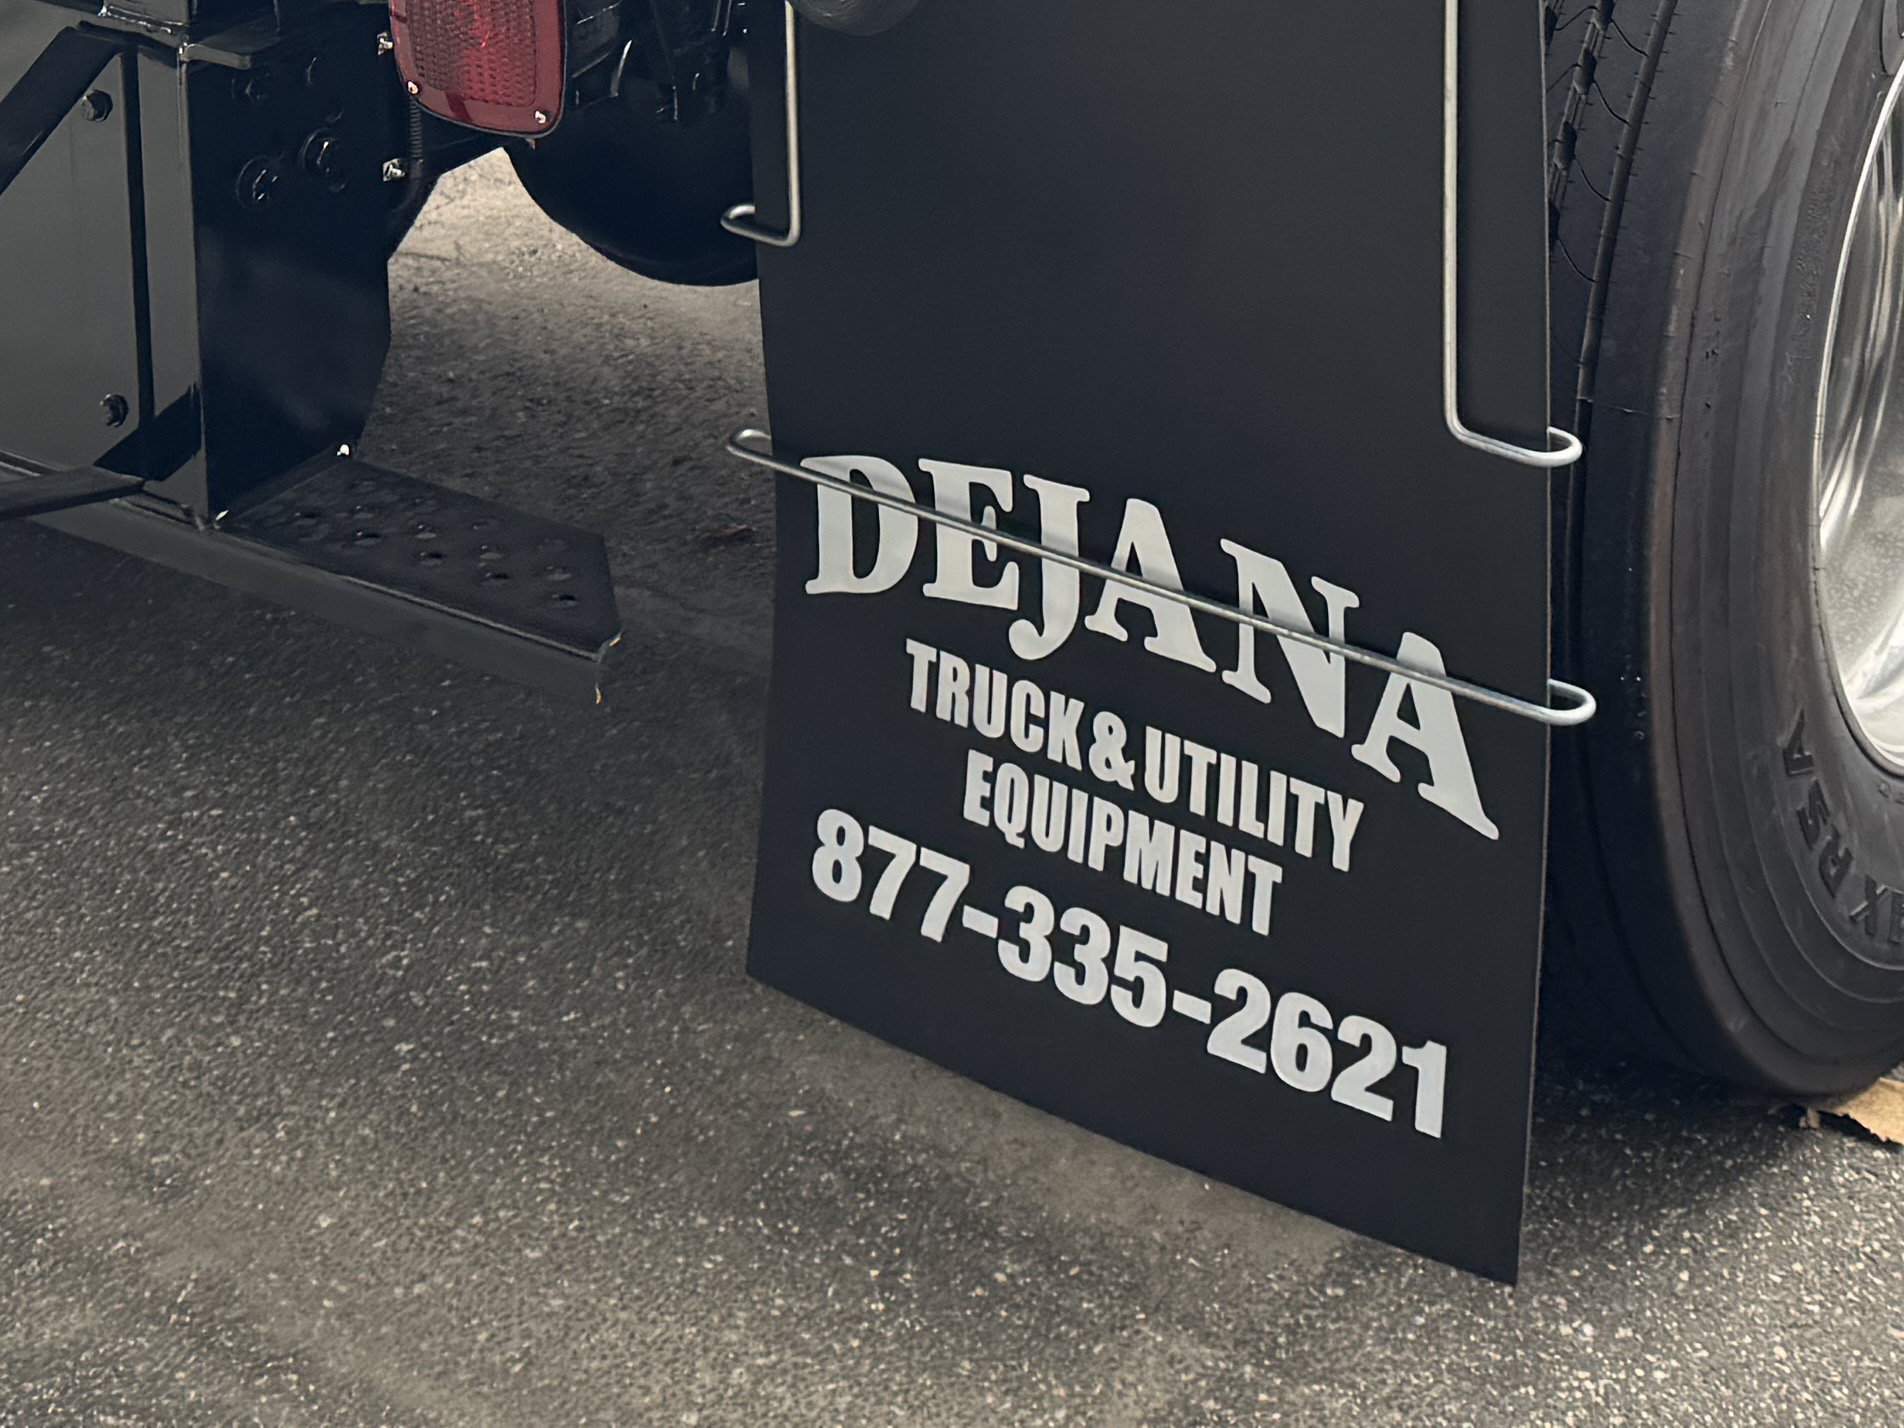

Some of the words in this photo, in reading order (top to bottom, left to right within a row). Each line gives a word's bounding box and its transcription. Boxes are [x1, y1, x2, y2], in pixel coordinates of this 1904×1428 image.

[799, 454, 1500, 841] DEJANA
[811, 808, 1448, 1140] 877-335-2621
[963, 749, 1284, 937] EQUIPMENT
